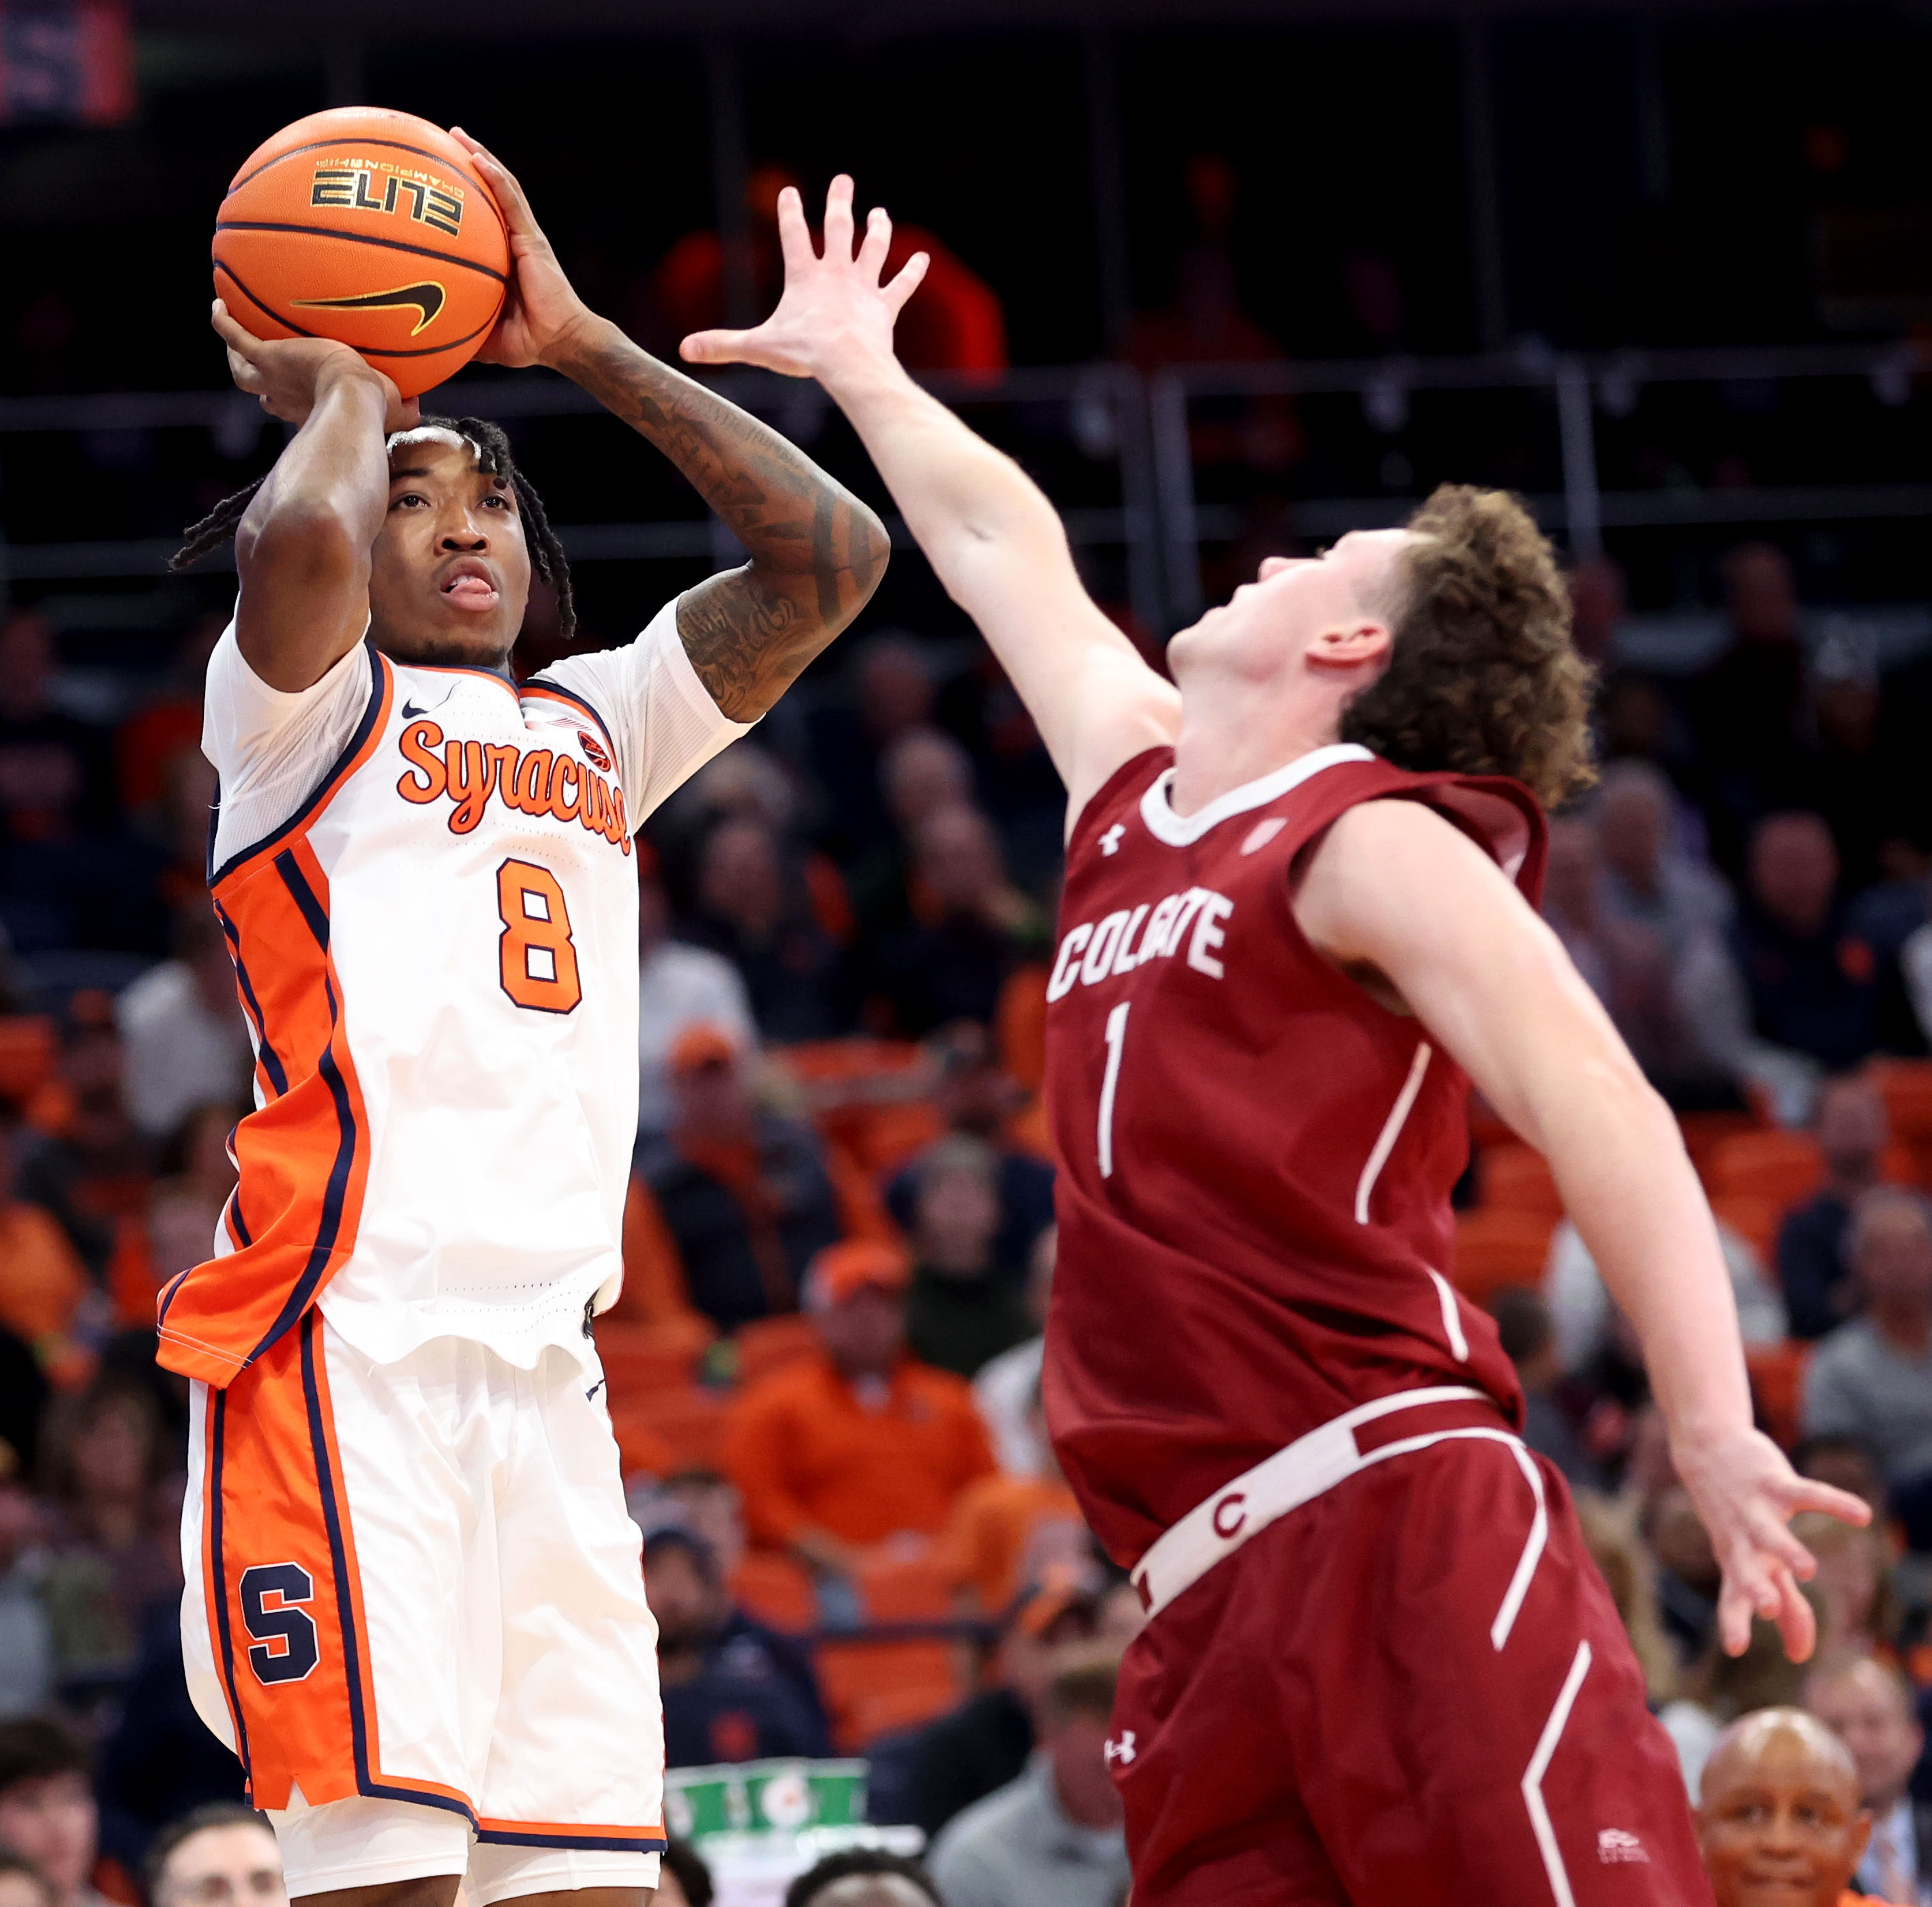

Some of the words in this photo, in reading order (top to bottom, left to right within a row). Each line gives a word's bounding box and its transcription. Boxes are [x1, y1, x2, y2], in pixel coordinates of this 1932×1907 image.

[310, 168, 465, 240] ELITE
[396, 720, 631, 857] Syracuse
[496, 857, 583, 1015] 8
[1097, 1001, 1132, 1179] 1
[1212, 1493, 1247, 1540] C
[239, 1561, 320, 1686] S
